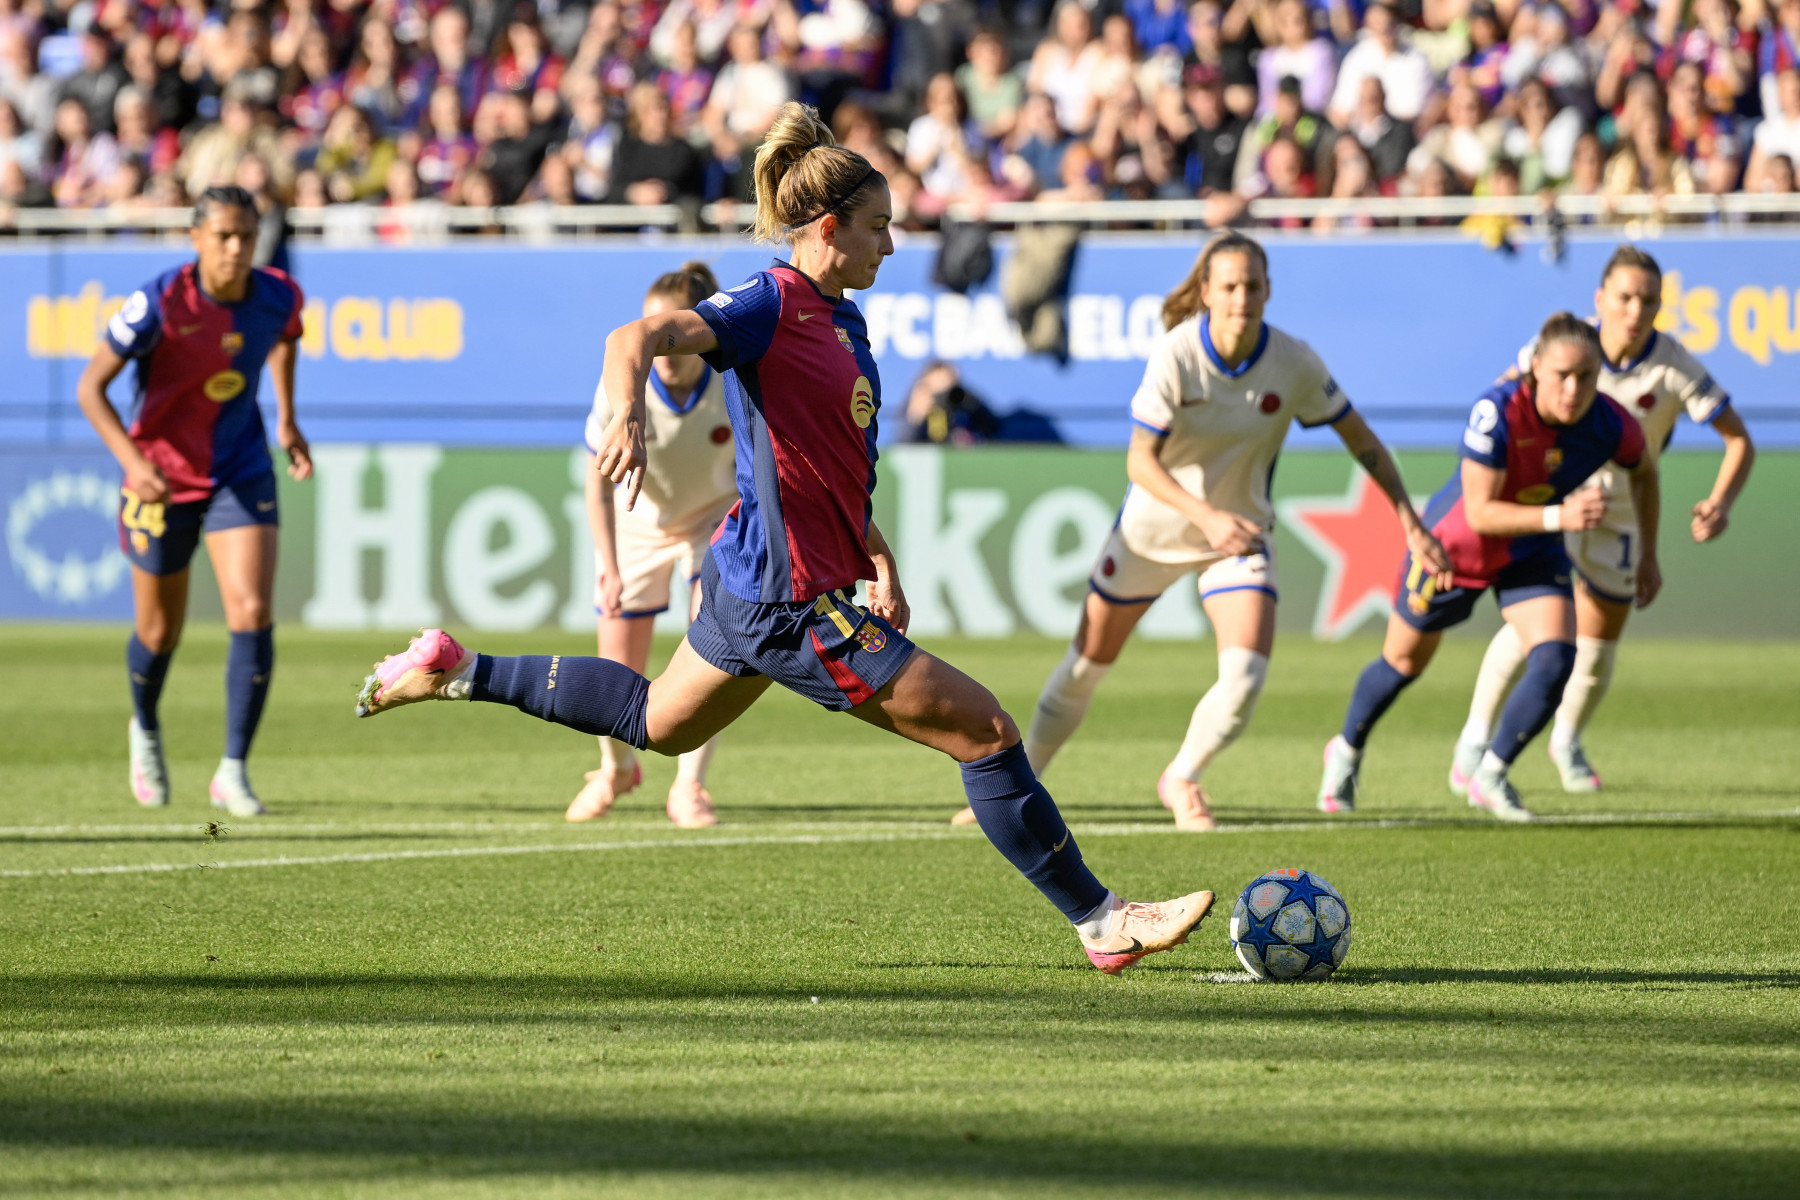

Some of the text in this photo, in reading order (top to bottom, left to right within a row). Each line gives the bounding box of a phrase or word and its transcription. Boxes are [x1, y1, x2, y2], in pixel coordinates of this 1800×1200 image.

[330, 296, 464, 361] CLUB
[864, 292, 1166, 360] FC BAELO
[302, 442, 1205, 638] Heike
[547, 655, 561, 690] ARÇA
